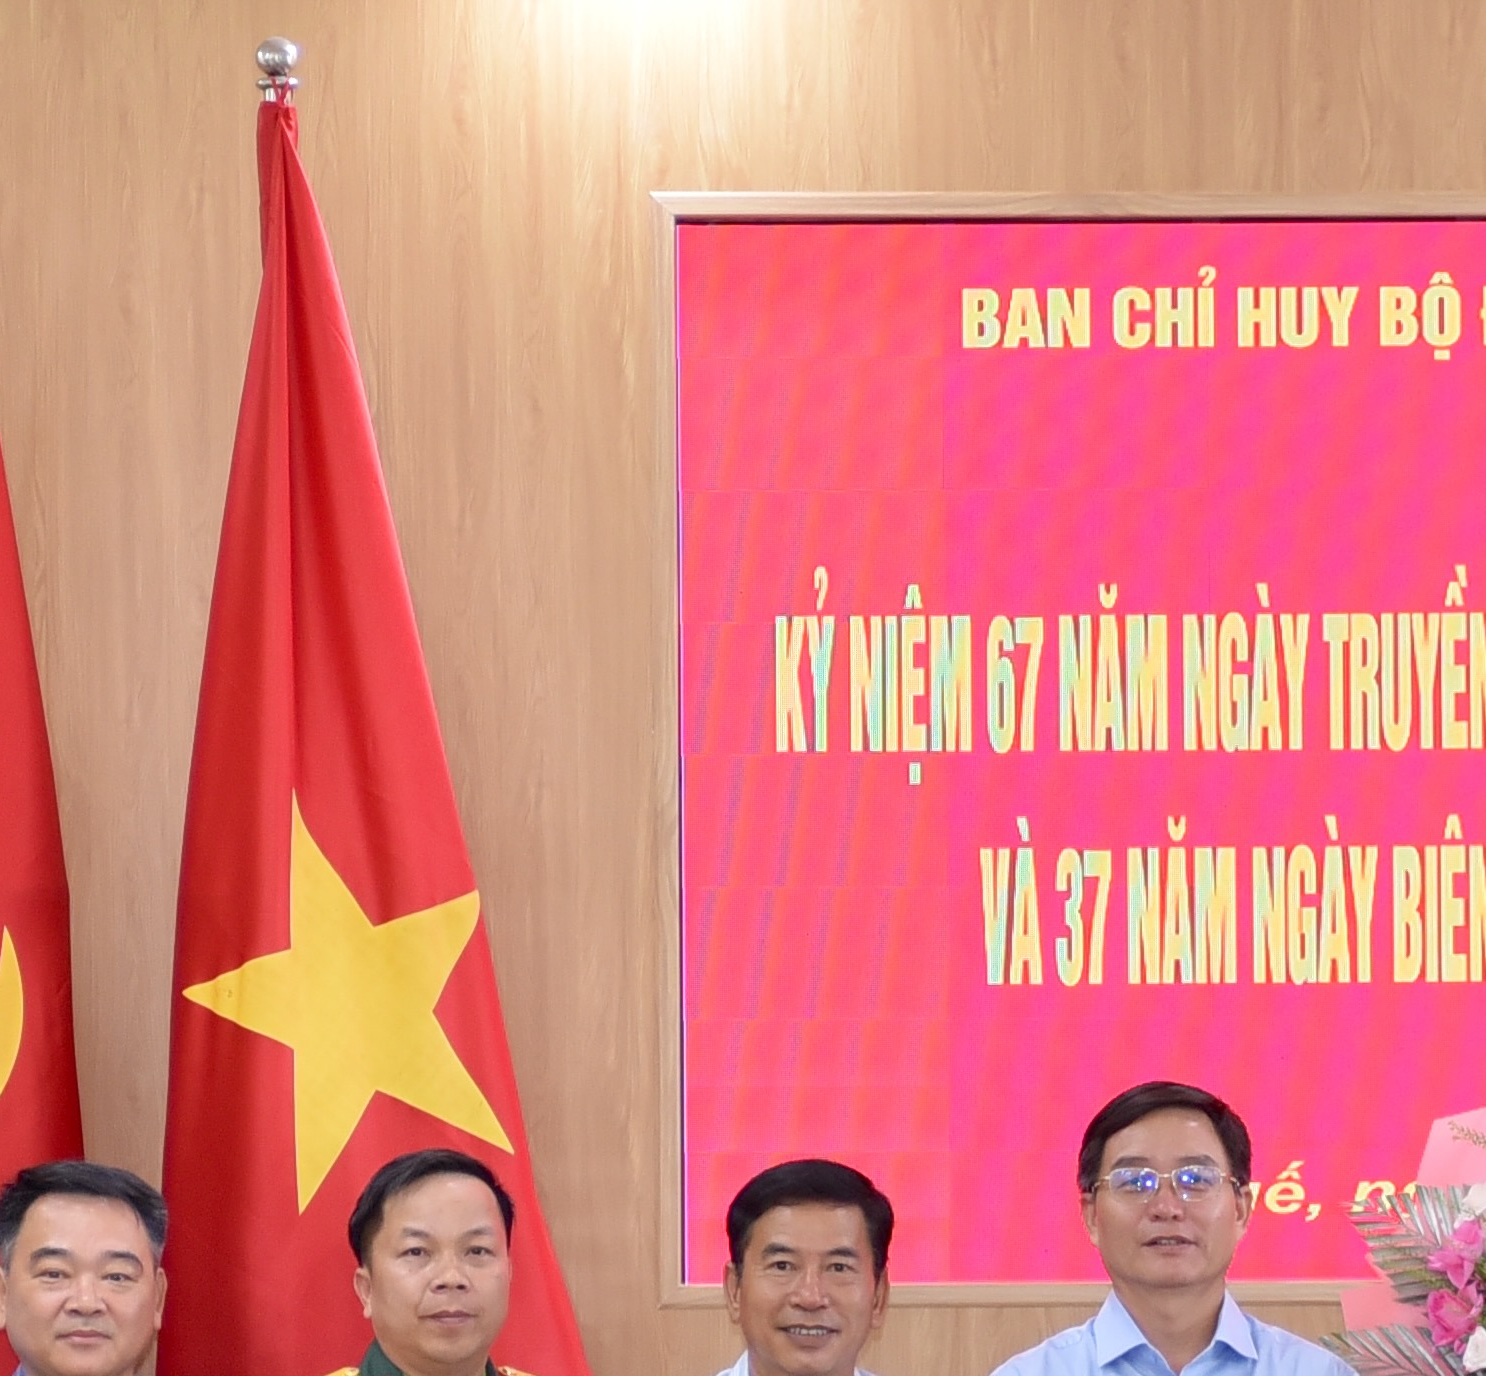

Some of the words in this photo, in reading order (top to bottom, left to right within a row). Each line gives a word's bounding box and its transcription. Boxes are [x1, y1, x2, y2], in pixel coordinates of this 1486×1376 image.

[961, 287, 1091, 349] BAN
[1112, 266, 1217, 349] CHỈ
[1237, 286, 1360, 349] HUY
[1379, 272, 1462, 361] BỘ
[774, 565, 836, 753] KỶ
[849, 583, 973, 786] NIỆM
[987, 614, 1045, 754] 67
[1058, 583, 1169, 752] NĂM
[1182, 582, 1311, 753] NGÀY
[979, 816, 1043, 986] VÀ
[1055, 847, 1112, 987] 37
[1126, 815, 1238, 985] NĂM
[1252, 814, 1379, 986] NGÀY
